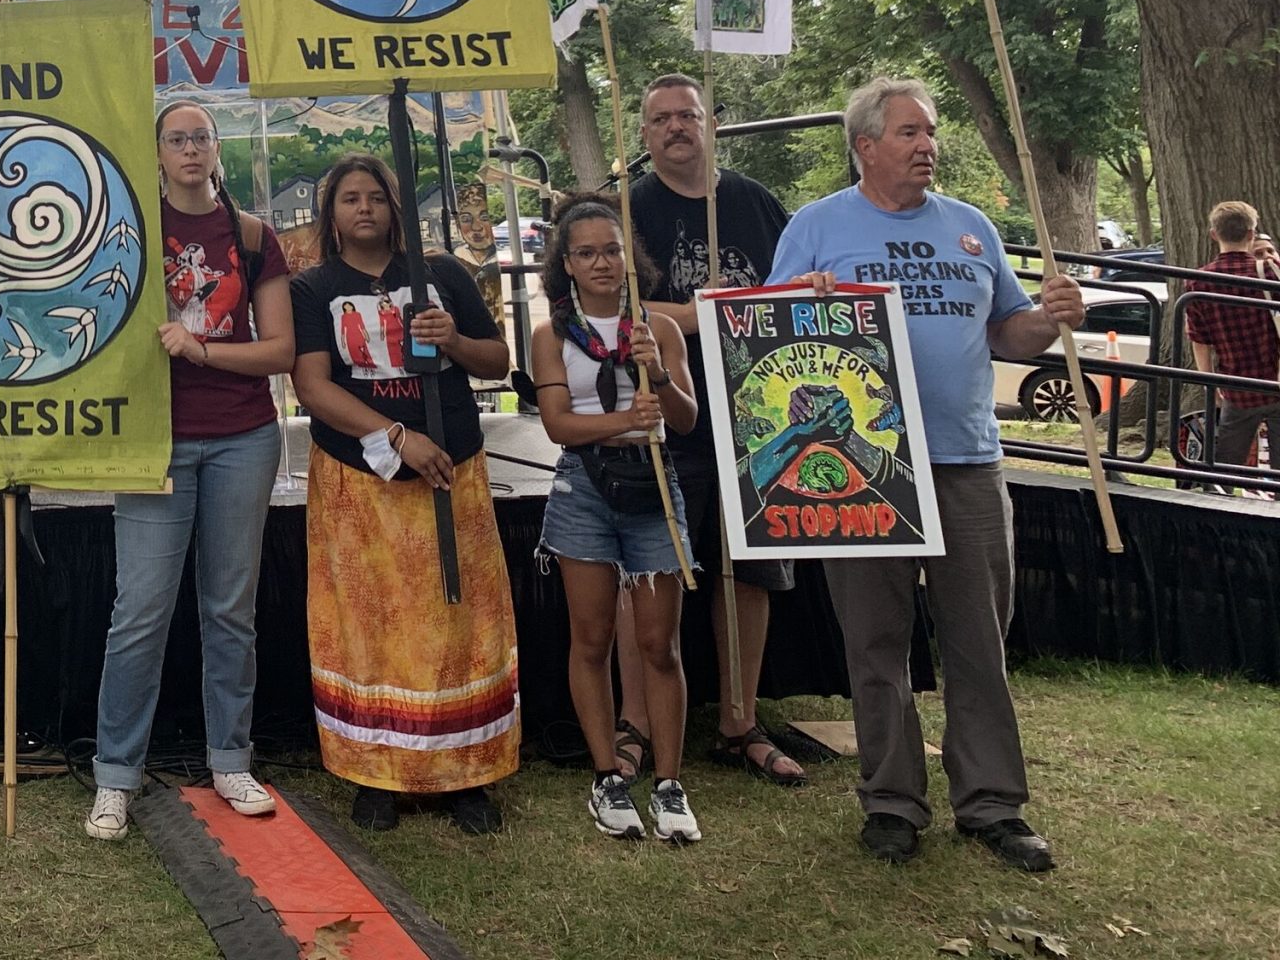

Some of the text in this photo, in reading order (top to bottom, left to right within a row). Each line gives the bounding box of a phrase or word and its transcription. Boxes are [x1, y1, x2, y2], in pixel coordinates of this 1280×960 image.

[297, 32, 512, 70] WE RESIST
[885, 241, 935, 259] NO
[854, 261, 976, 282] FRACKING
[901, 284, 944, 300] GAS
[722, 301, 878, 338] WE RISE
[903, 302, 976, 318] ELINE
[753, 343, 870, 382] NOT JUST FOR
[775, 360, 844, 383] YOU & ME
[764, 502, 896, 538] STOP MVP
